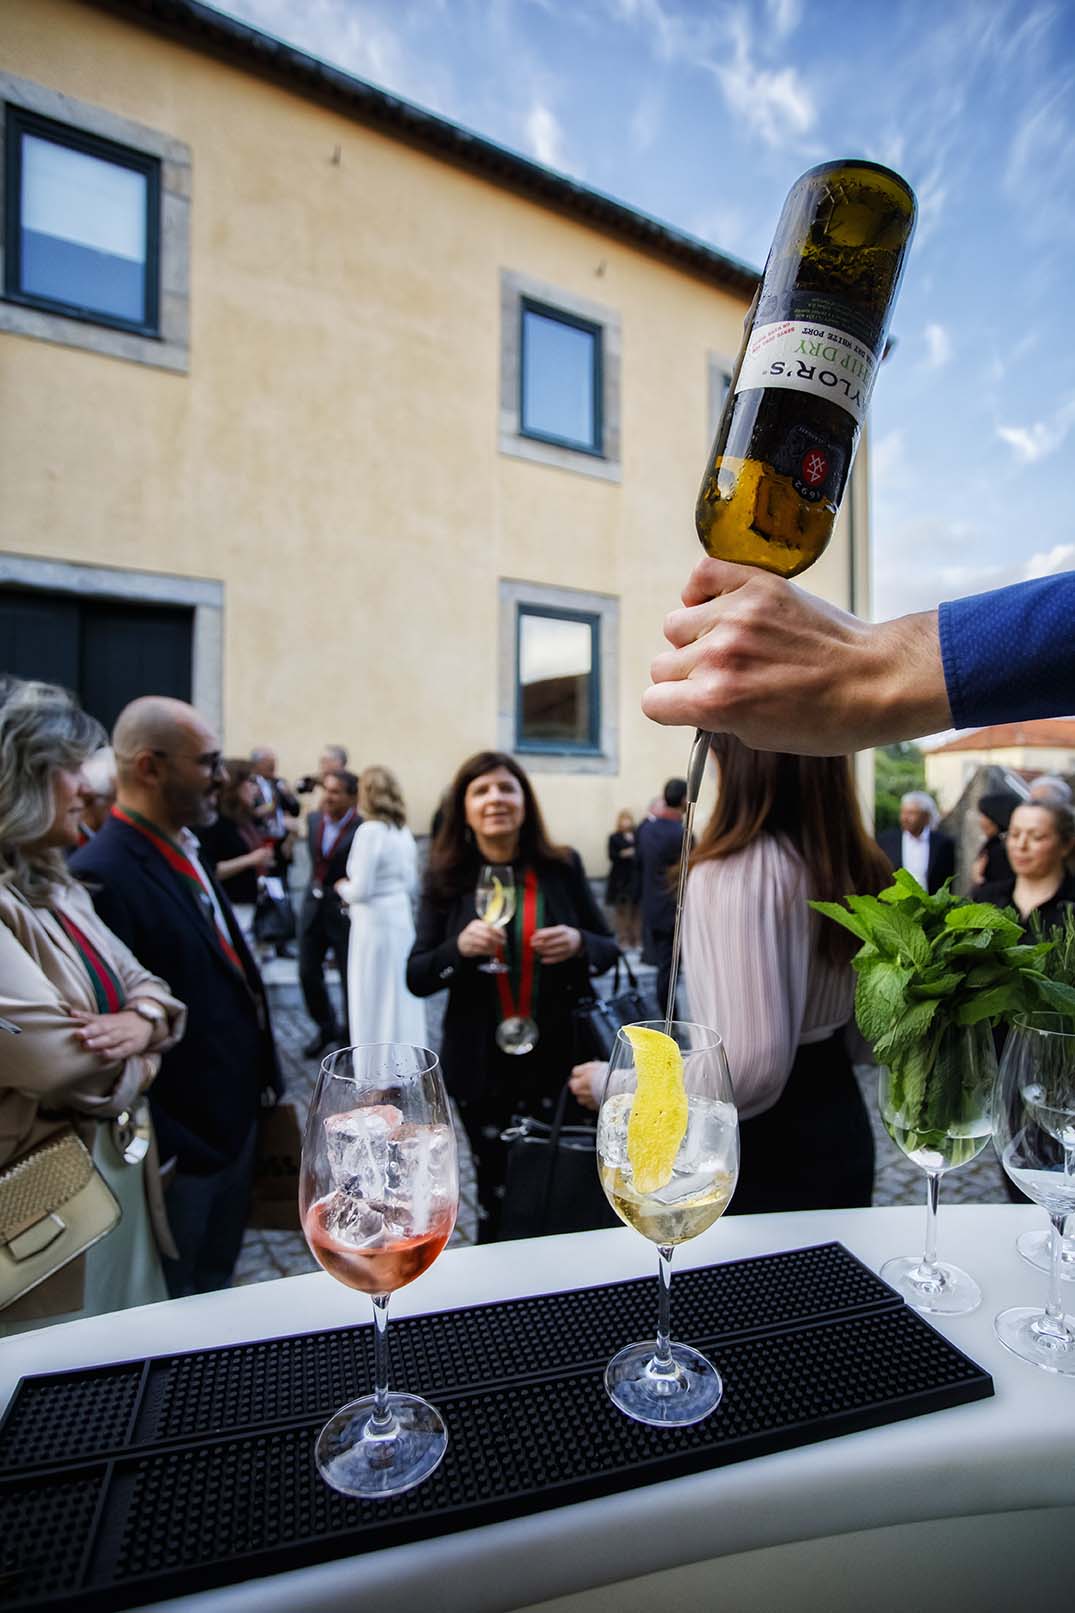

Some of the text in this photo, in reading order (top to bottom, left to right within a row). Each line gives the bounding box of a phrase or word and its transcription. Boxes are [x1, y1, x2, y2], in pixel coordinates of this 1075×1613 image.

[802, 327, 825, 338] PORT
[826, 333, 852, 349] WHITE
[795, 339, 838, 362] DRY
[841, 355, 869, 384] HIP
[770, 360, 865, 408] YLOR'S
[795, 480, 820, 499] 1692
